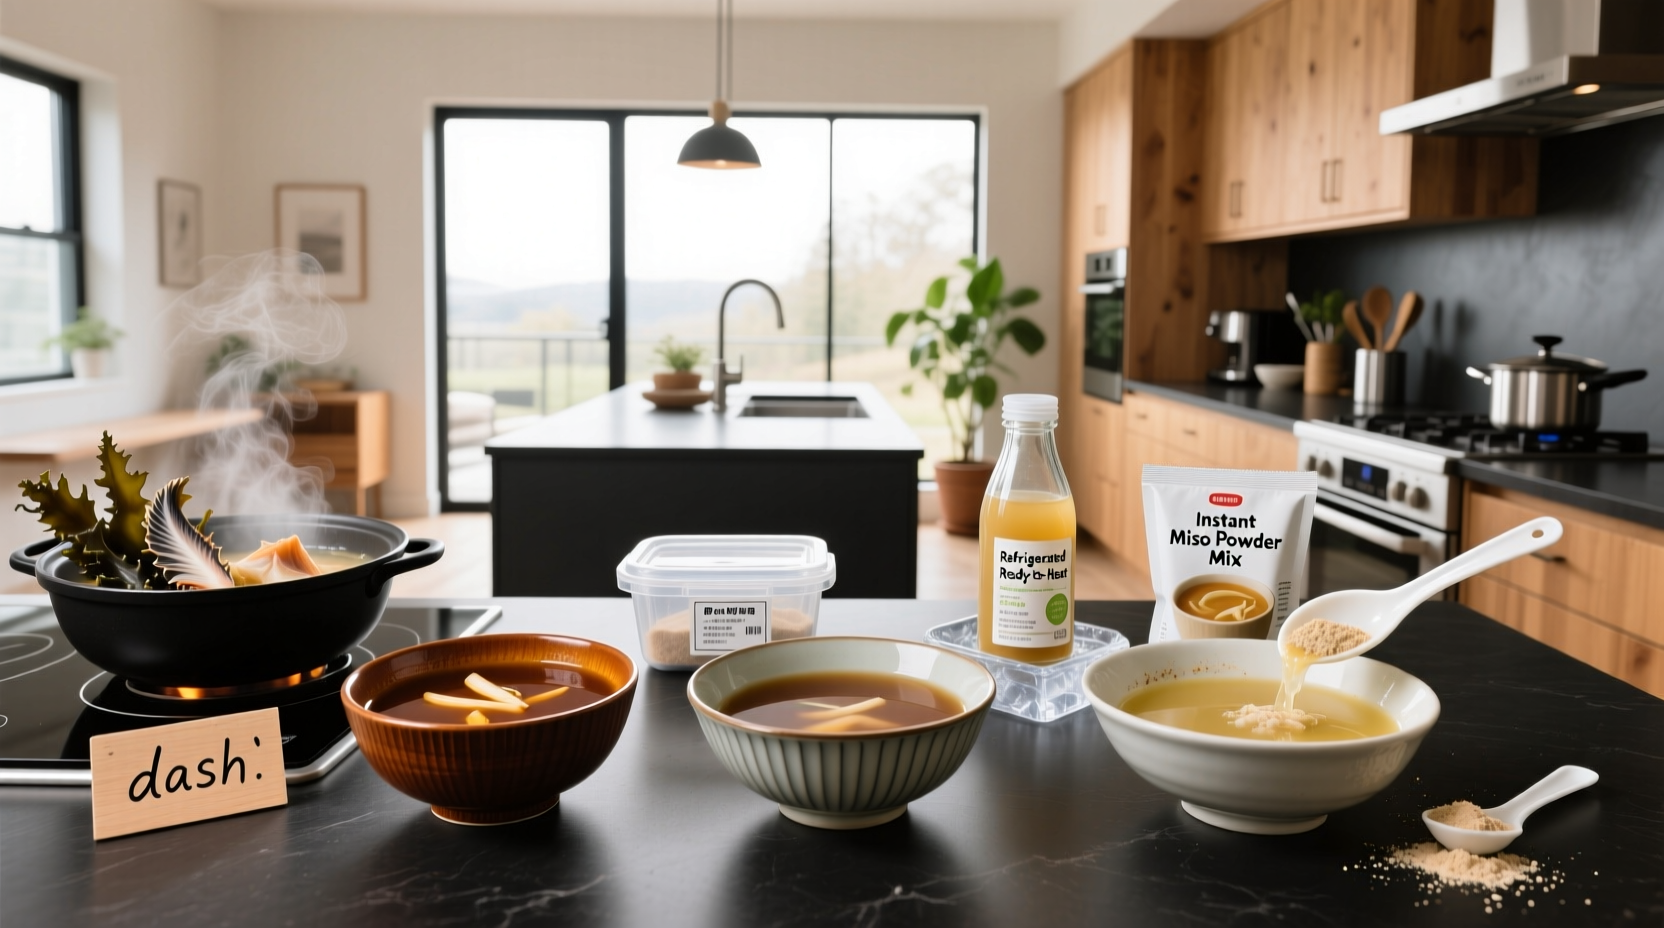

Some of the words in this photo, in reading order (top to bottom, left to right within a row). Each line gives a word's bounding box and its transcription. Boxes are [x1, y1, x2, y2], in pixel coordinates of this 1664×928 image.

[1196, 512, 1257, 528] Instant
[1170, 529, 1211, 546] Miso
[1216, 530, 1283, 550] Powder
[1208, 549, 1242, 567] Mix
